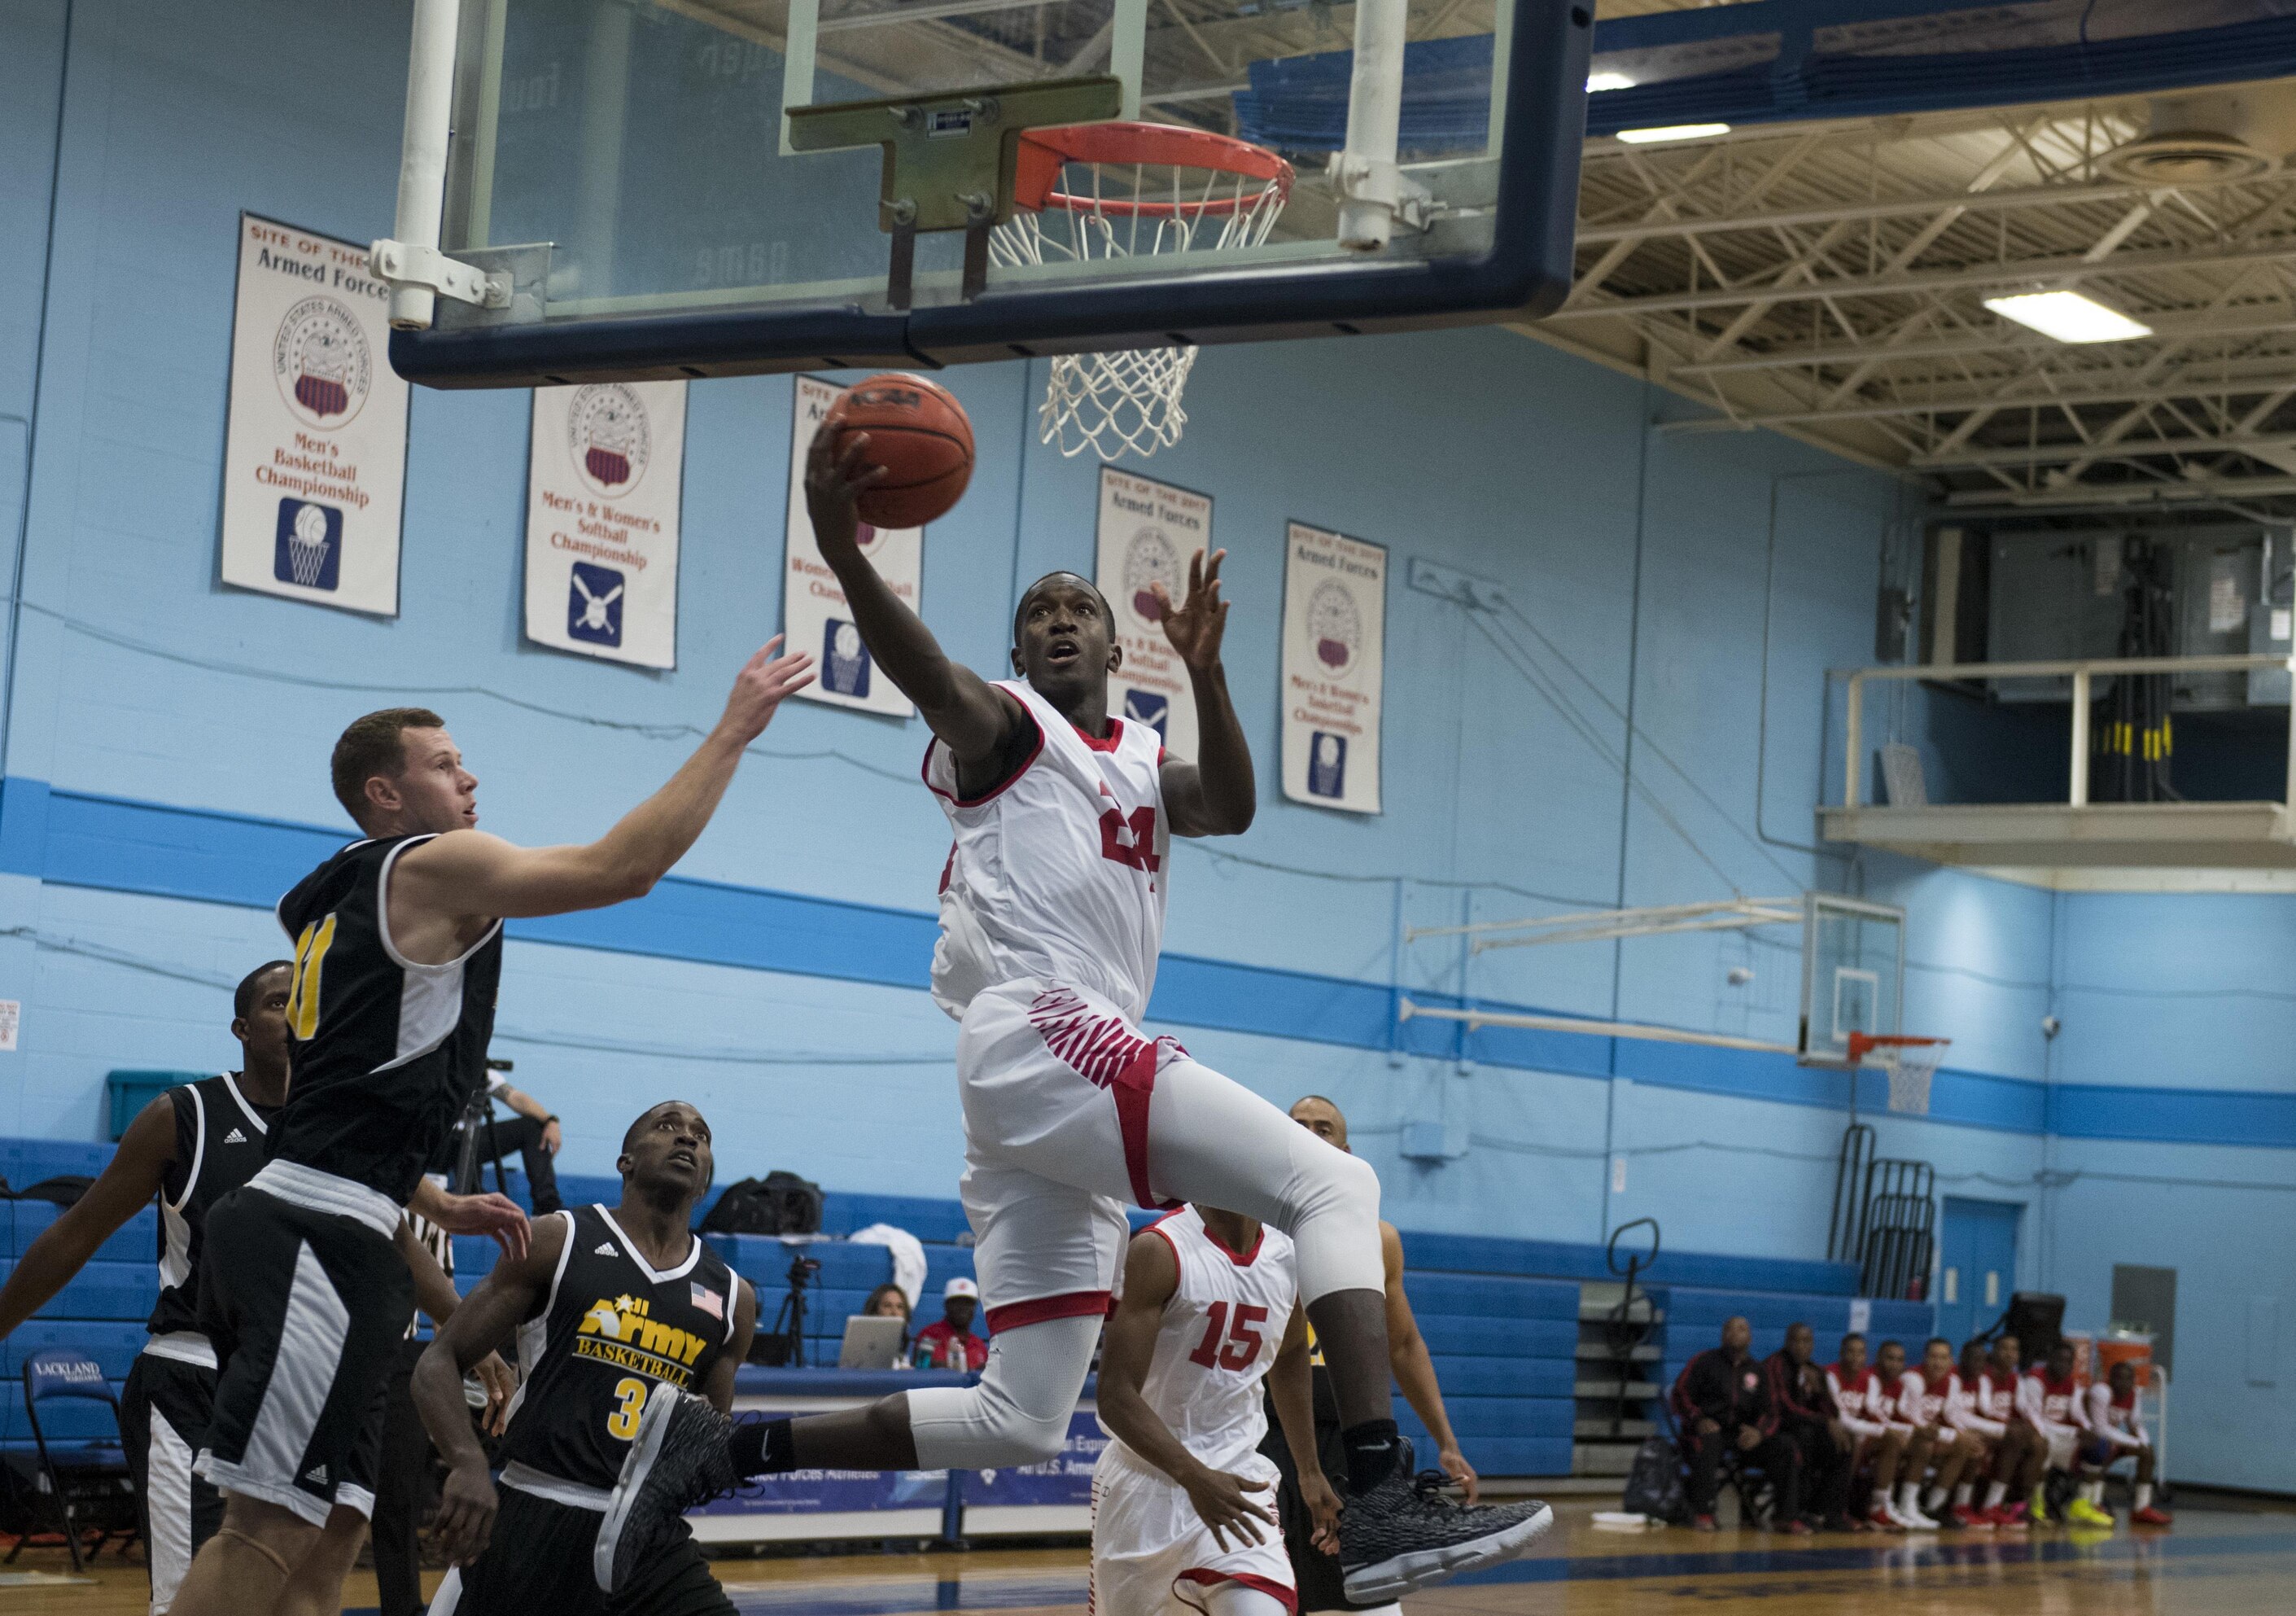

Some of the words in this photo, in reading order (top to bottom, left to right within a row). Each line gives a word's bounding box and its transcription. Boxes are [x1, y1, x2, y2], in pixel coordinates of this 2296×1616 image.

[251, 226, 291, 249] SITE
[298, 239, 322, 255] OF
[331, 249, 364, 270] THE
[257, 247, 326, 284] Armed
[334, 268, 391, 302] Force
[273, 446, 357, 483] Basketball
[295, 431, 339, 458] Men's
[255, 463, 370, 510] Championship
[542, 489, 584, 516] Men's
[602, 504, 661, 535] Women's
[577, 517, 628, 545] Softball
[1112, 491, 1154, 518] Armed
[1158, 504, 1200, 531] Forces
[550, 531, 647, 572] Championship
[1297, 545, 1336, 568] Armed
[1339, 556, 1378, 580] Forces
[577, 1298, 707, 1366] Army
[1188, 1300, 1269, 1372] 15
[34, 1360, 100, 1377] LACKLAND
[577, 1338, 690, 1388] BASKETBALL
[607, 1377, 648, 1442] 3
